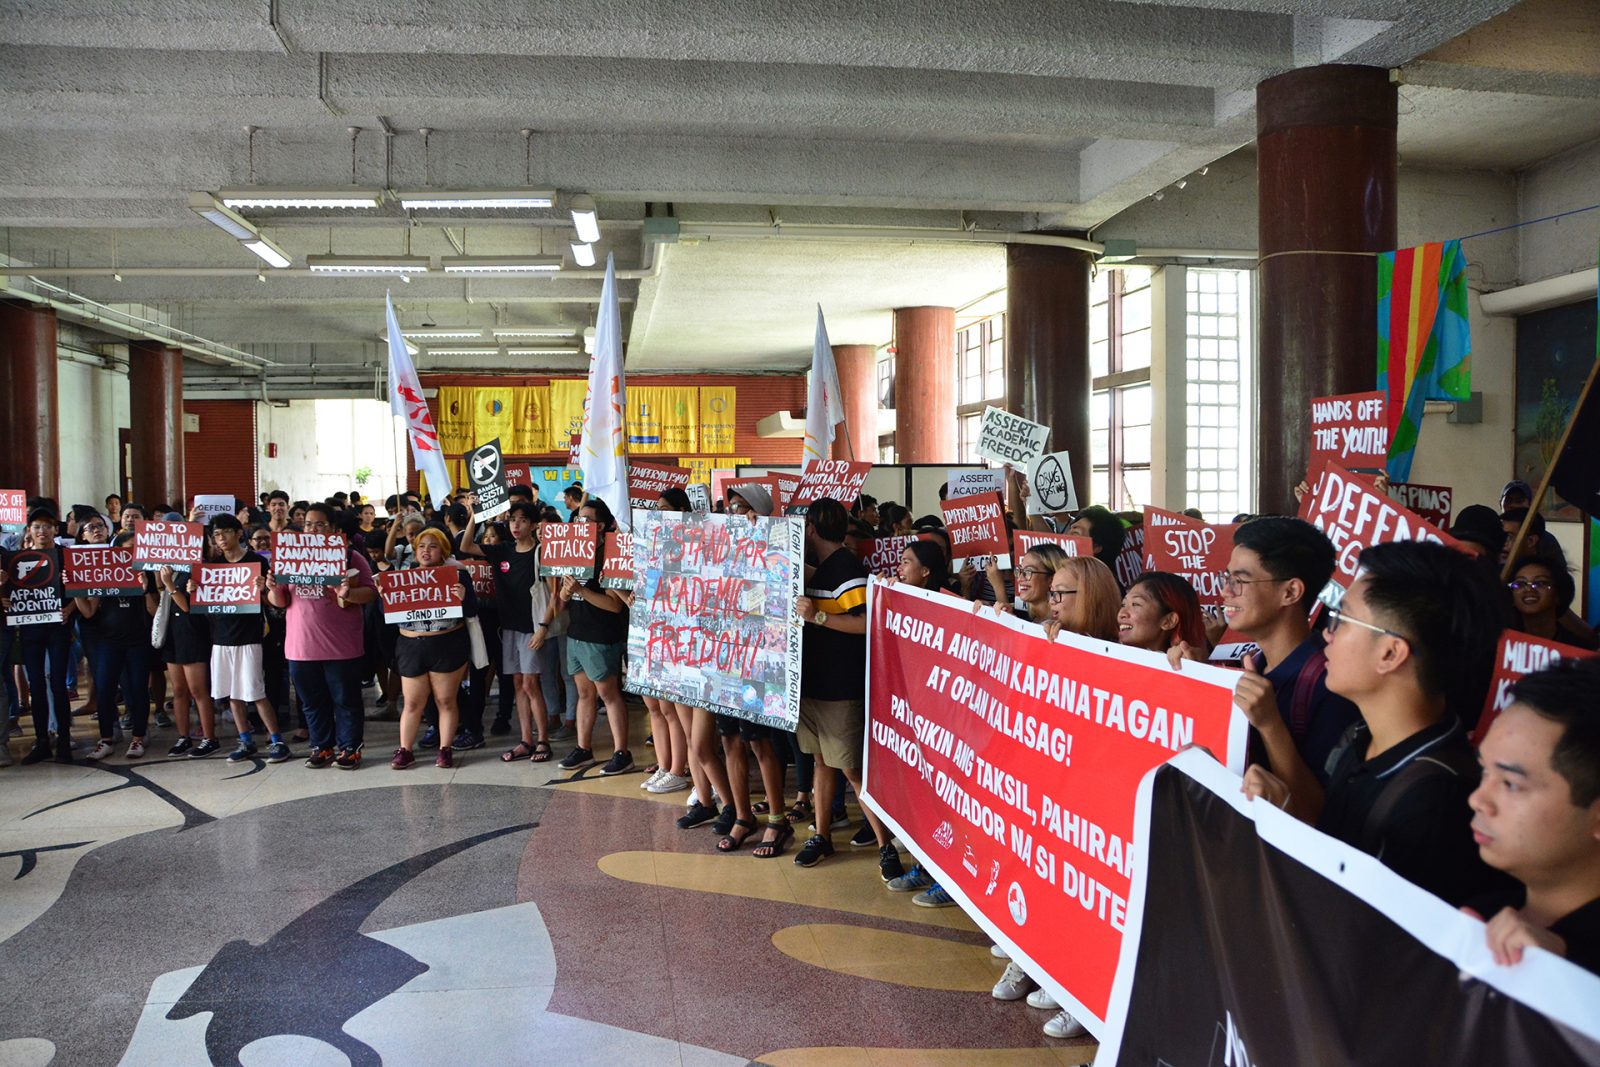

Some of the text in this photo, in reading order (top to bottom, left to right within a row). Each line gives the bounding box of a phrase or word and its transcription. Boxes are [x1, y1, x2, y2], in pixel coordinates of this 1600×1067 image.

[1312, 399, 1383, 424] HANDS OFF
[986, 411, 1038, 437] ASSERT
[983, 424, 1041, 452] ACADEMIC
[1314, 426, 1388, 459] THE YOUTH!
[981, 437, 1034, 463] FREEDO
[816, 460, 850, 474] NO TO
[800, 473, 868, 487] MARTIAL LAW
[11, 494, 23, 507] OFF
[797, 486, 814, 499] IN
[811, 485, 859, 502] SCHOOLS
[1320, 472, 1444, 547] DEFEN
[146, 523, 187, 534] NO TO
[544, 523, 590, 539] STOP THE
[136, 533, 204, 549] MARTIAL LAW
[277, 533, 345, 547] MILITAR SA
[616, 533, 634, 548] STO
[649, 523, 768, 569] I STAND FOR
[791, 521, 803, 560] FIGHT
[1164, 527, 1216, 557] STOP
[72, 549, 132, 566] DEFEND
[135, 547, 202, 561] IN SCHOOLS!
[543, 538, 595, 560] ATTACKS
[620, 545, 634, 557] THE
[602, 558, 634, 571] ATTAC
[863, 549, 903, 569] ACADE
[1177, 555, 1207, 570] THE
[73, 567, 135, 583] NEGROS
[201, 566, 251, 585] DEFEND
[550, 566, 574, 575] STAND
[791, 561, 801, 579] FOR
[289, 575, 325, 584] STAND UP
[608, 580, 622, 588] LFS
[1174, 571, 1222, 597] TACK
[88, 588, 120, 596] LFS UPD
[196, 584, 258, 602] NEGROS!
[295, 586, 324, 597] ROAR
[384, 584, 452, 606] VFA-EDCA!
[651, 576, 751, 621] ACADEMIC
[26, 598, 63, 611] ENTRY!
[207, 605, 237, 613] LFS UPD
[16, 613, 53, 624] LFS UPD
[406, 608, 447, 621] STAND UP
[788, 599, 800, 668] OCRATIC
[647, 620, 762, 679] FREEDOM!
[946, 632, 980, 666] ANG
[979, 643, 1011, 686] OPLAN
[1009, 659, 1194, 752] KAPANATAGAN
[926, 664, 1073, 768] AT OPLAN KALASAG!
[953, 738, 975, 778] ANG
[975, 755, 1037, 827] TAKSIL,
[935, 769, 1007, 847] DIKTADOR
[1010, 822, 1033, 869] NA
[1034, 844, 1056, 886] SI
[1063, 860, 1126, 935] DUTE
